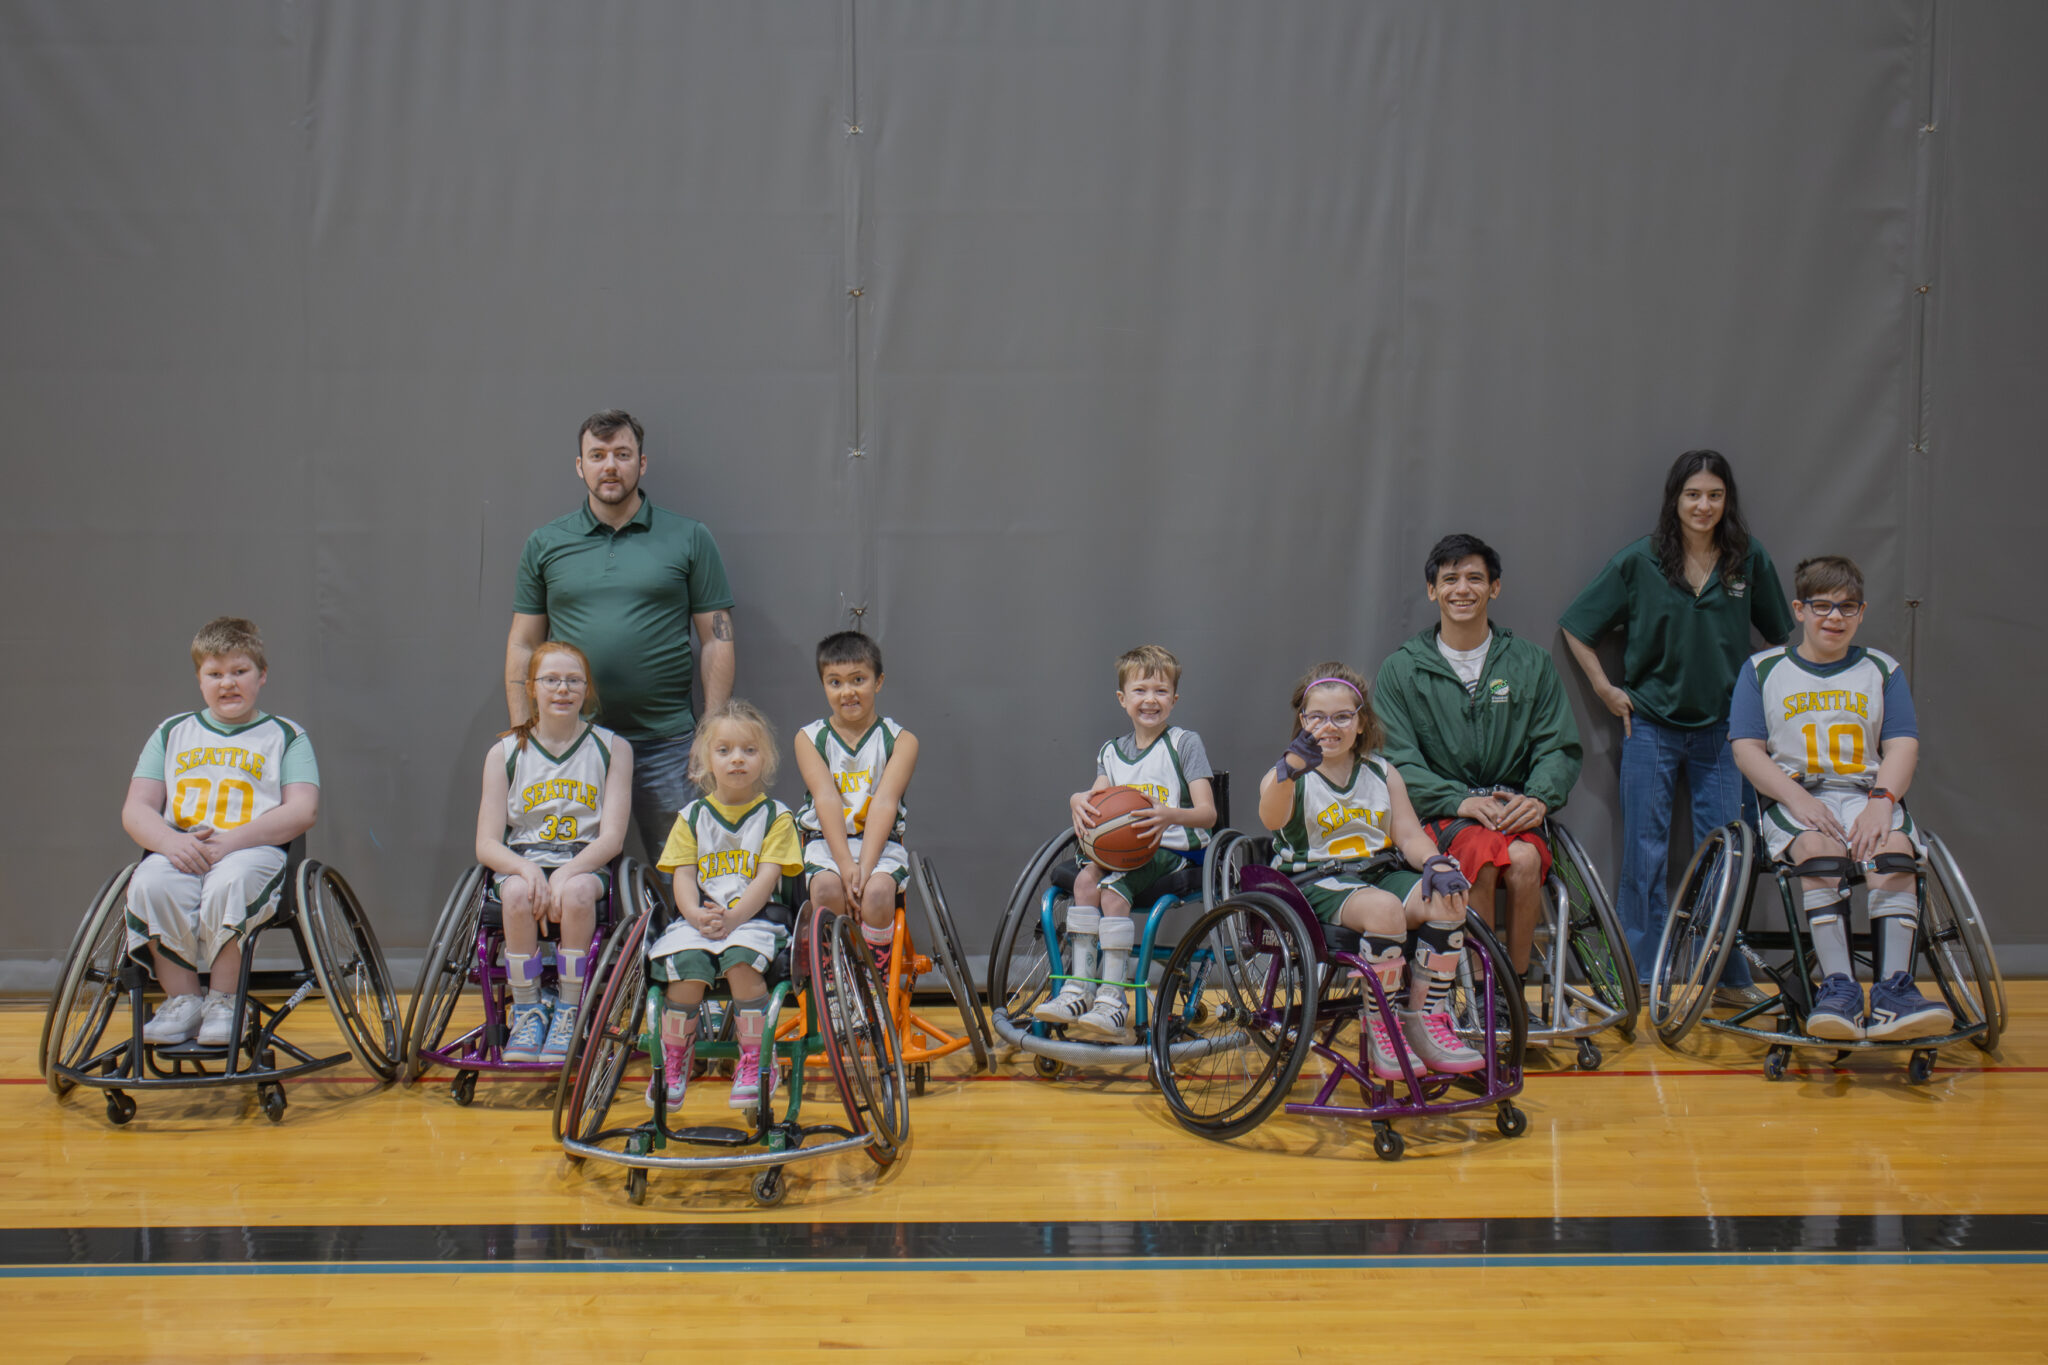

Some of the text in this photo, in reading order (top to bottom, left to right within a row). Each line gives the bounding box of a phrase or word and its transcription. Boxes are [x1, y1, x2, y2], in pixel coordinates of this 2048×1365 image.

[1783, 690, 1868, 721] SEATTLE
[175, 747, 266, 781] SEATTLE
[1801, 723, 1867, 775] 10
[172, 778, 254, 830] 00
[522, 778, 598, 814] SEATTLE
[539, 815, 578, 841] 33
